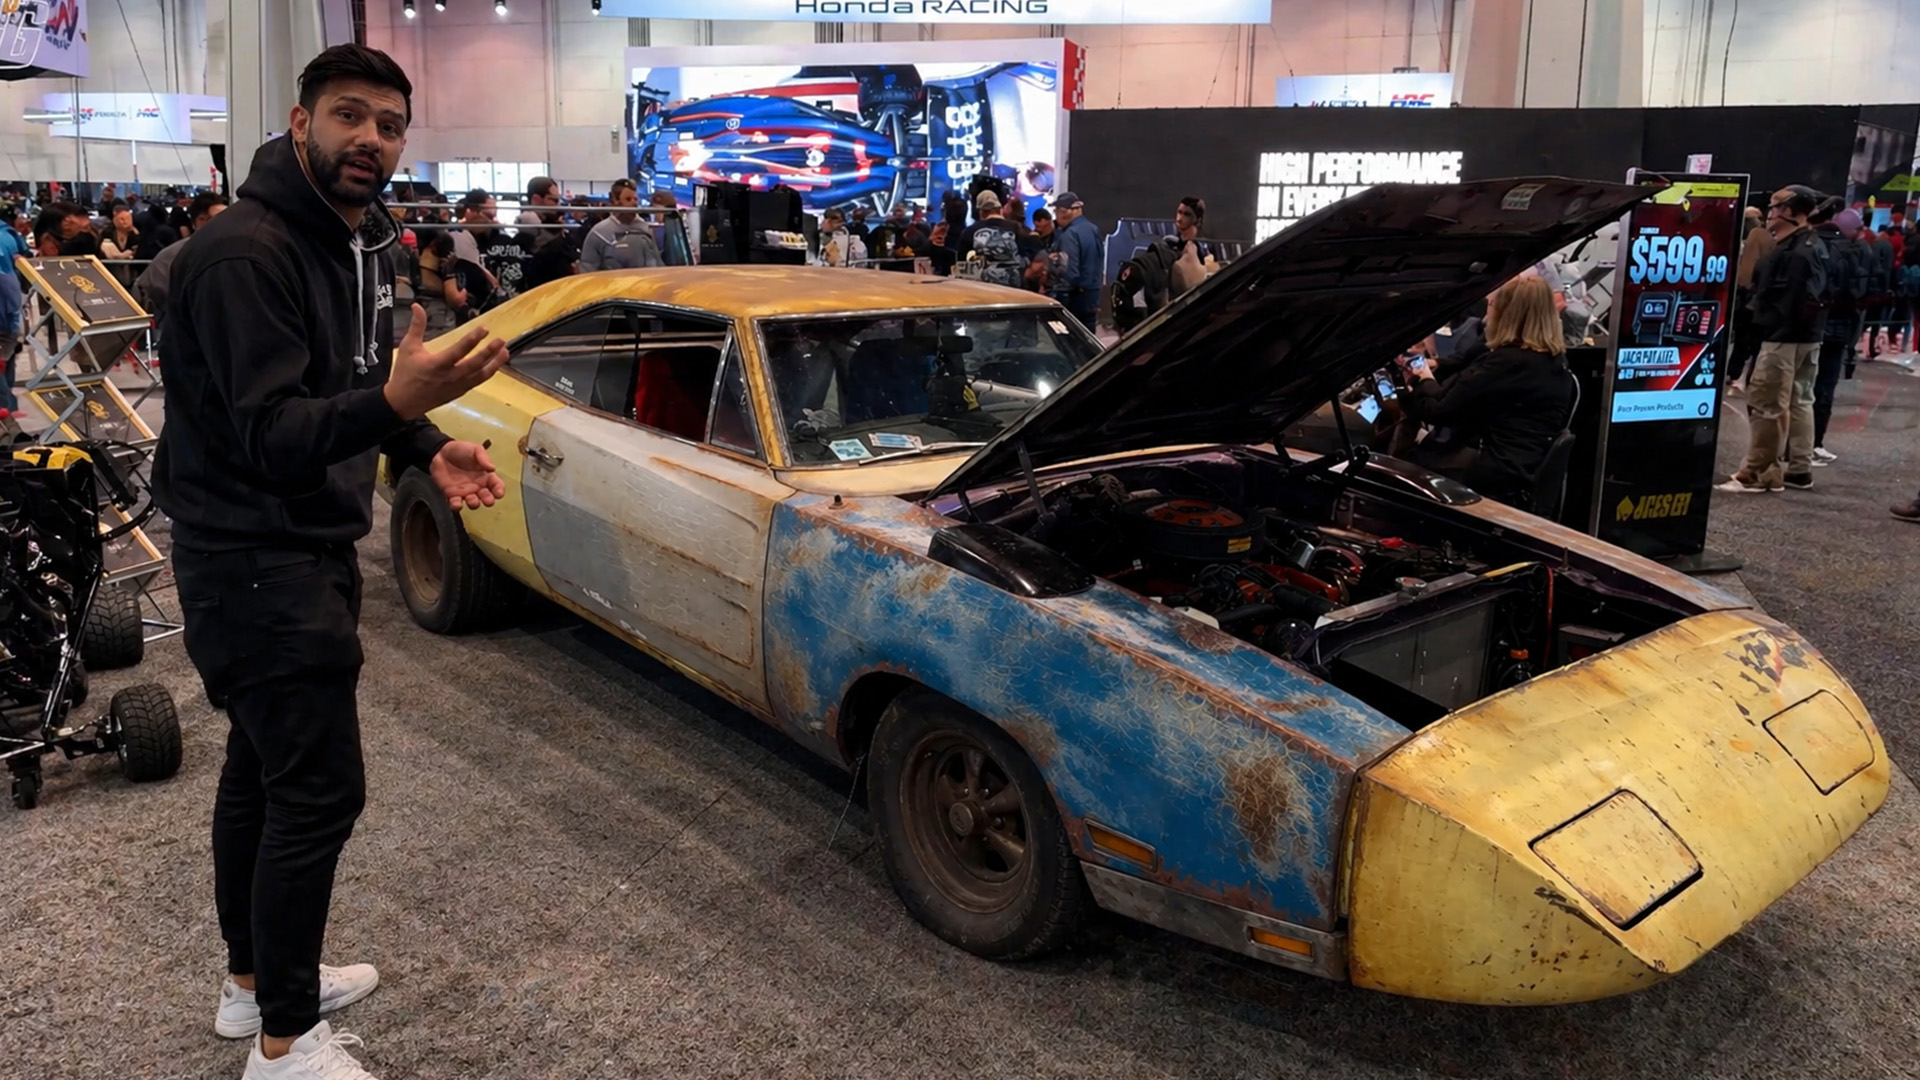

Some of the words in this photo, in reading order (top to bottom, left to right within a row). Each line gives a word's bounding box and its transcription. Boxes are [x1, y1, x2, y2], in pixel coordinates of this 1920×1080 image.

[796, 0, 913, 13] Honda
[922, 0, 1048, 13] RACING
[1259, 152, 1309, 184] HIGH
[1312, 151, 1463, 184] PERFORMANCE
[1257, 186, 1280, 217] IN
[1630, 235, 1728, 284] $599.99
